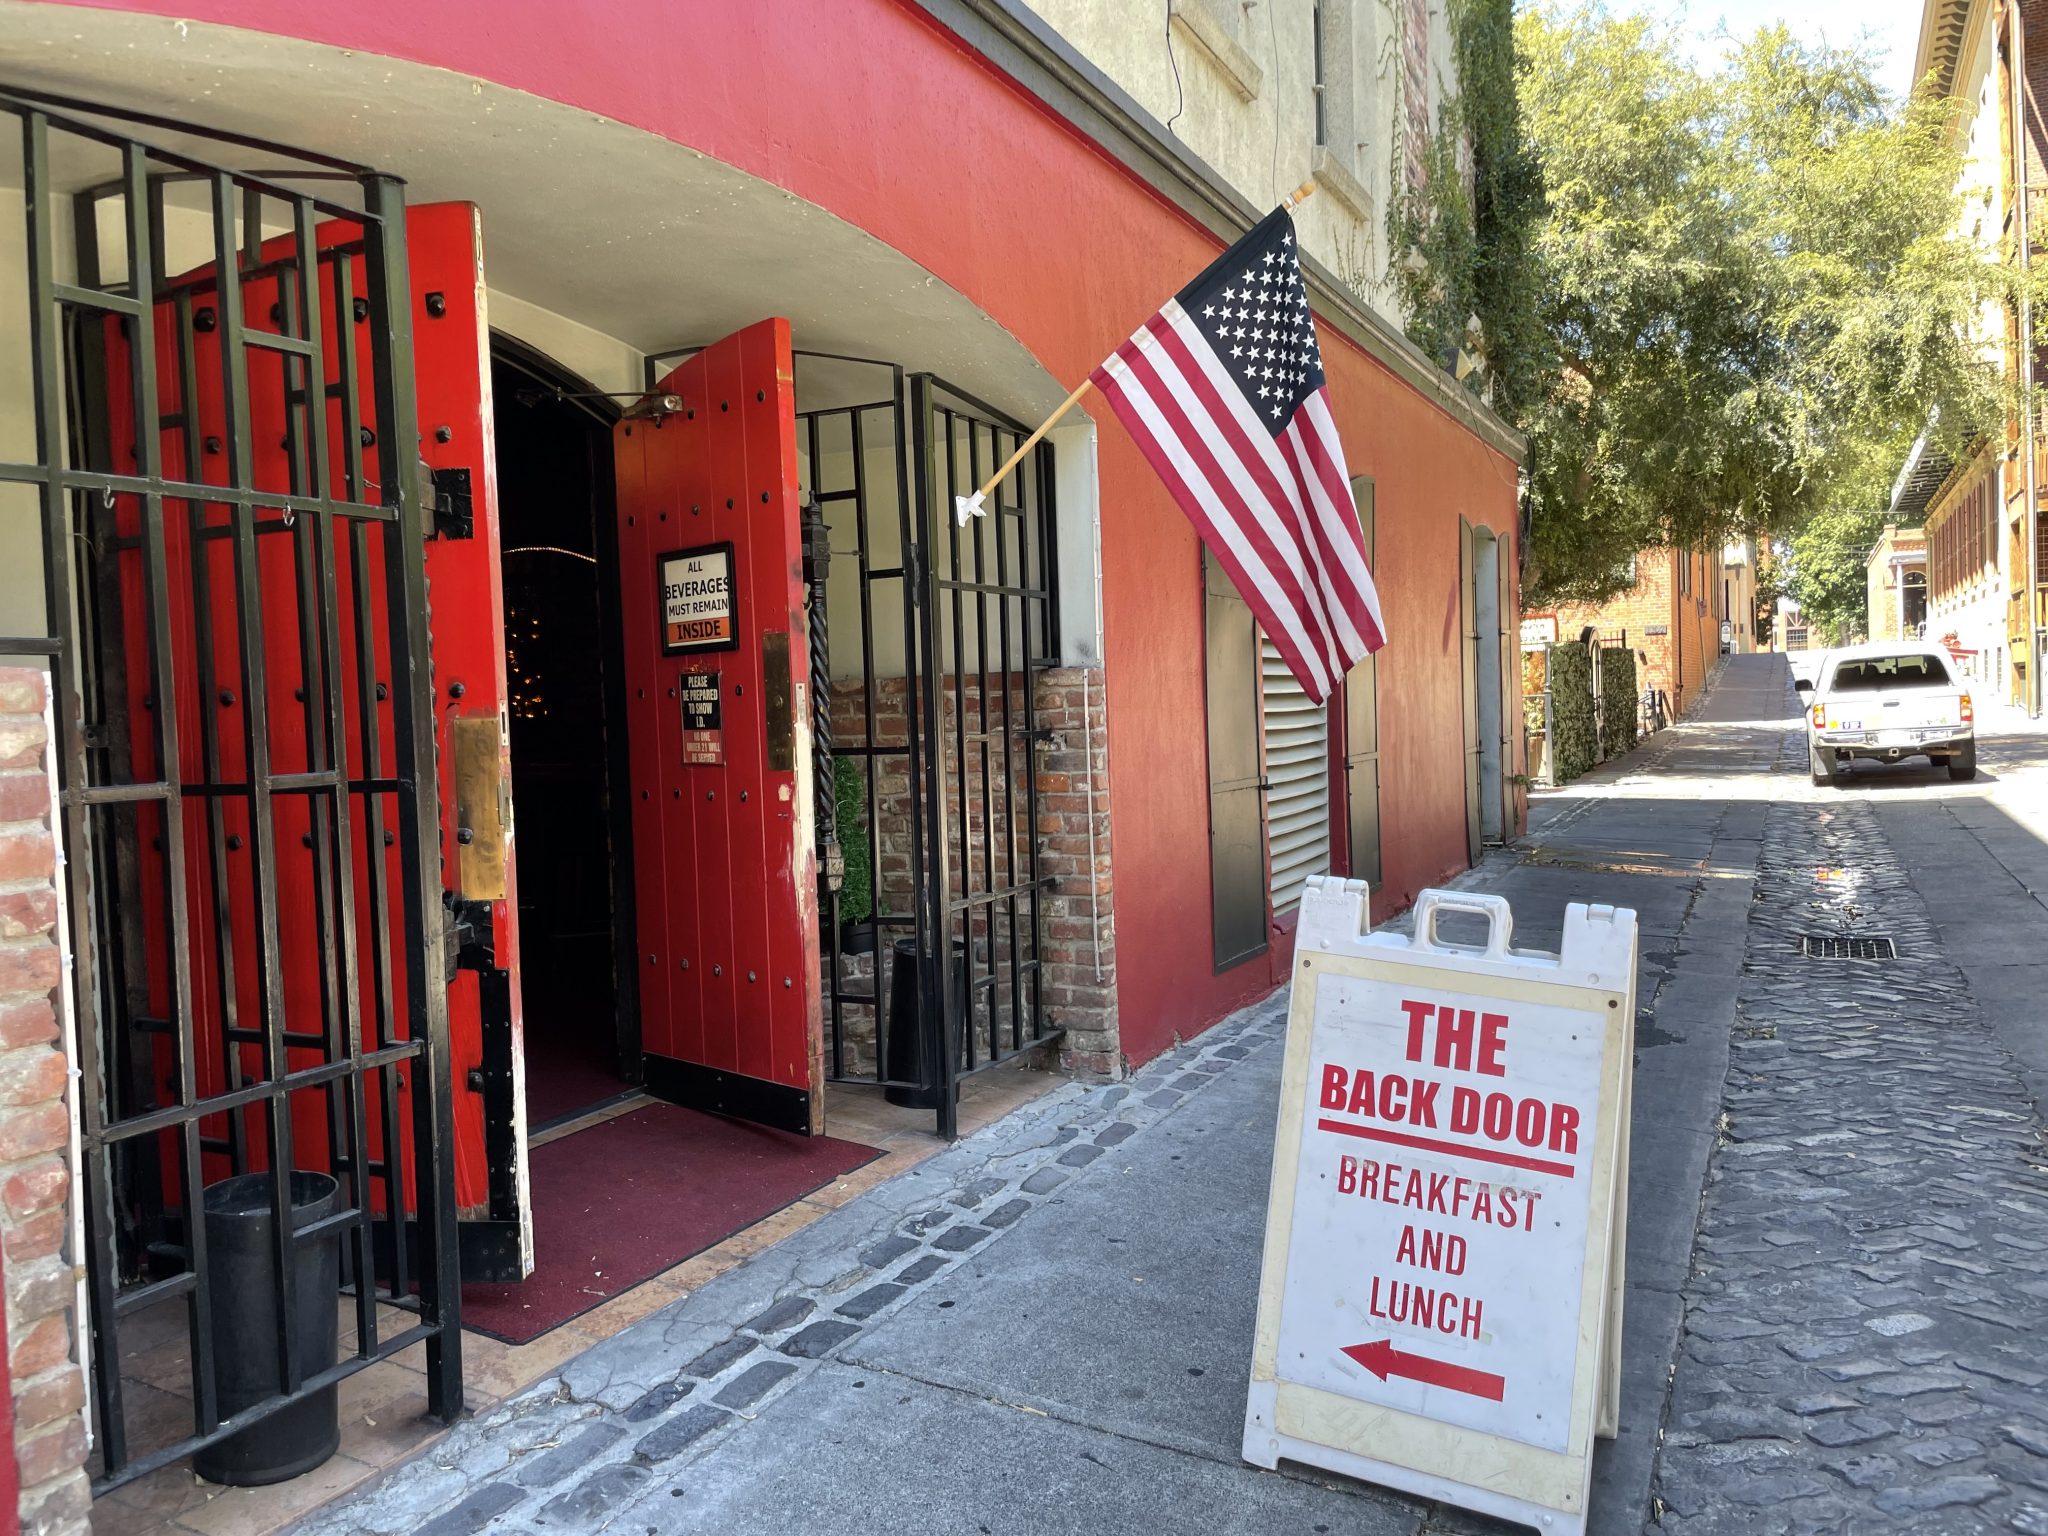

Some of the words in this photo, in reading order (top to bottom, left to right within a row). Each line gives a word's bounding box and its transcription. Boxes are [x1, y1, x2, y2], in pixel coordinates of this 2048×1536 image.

[688, 561, 703, 573] ALL
[665, 577, 729, 600] BEVERAGES
[668, 603, 691, 616] MUST
[693, 598, 728, 613] REMAIN
[677, 620, 721, 640] INSIDE
[688, 676, 708, 688] PLEASE
[682, 690, 690, 701] BE
[690, 689, 718, 701] PREPARED
[688, 703, 695, 714] TO
[696, 702, 712, 714] SHOW
[701, 732, 711, 741] ONE
[701, 742, 707, 752] 21
[708, 742, 720, 752] WILL
[1401, 999, 1509, 1077] THE
[1319, 1064, 1440, 1129] BACK
[1450, 1086, 1580, 1154] DOOR
[1338, 1154, 1542, 1232] BREAKFAST
[1396, 1225, 1467, 1276] AND
[1369, 1276, 1483, 1340] LUNCH
